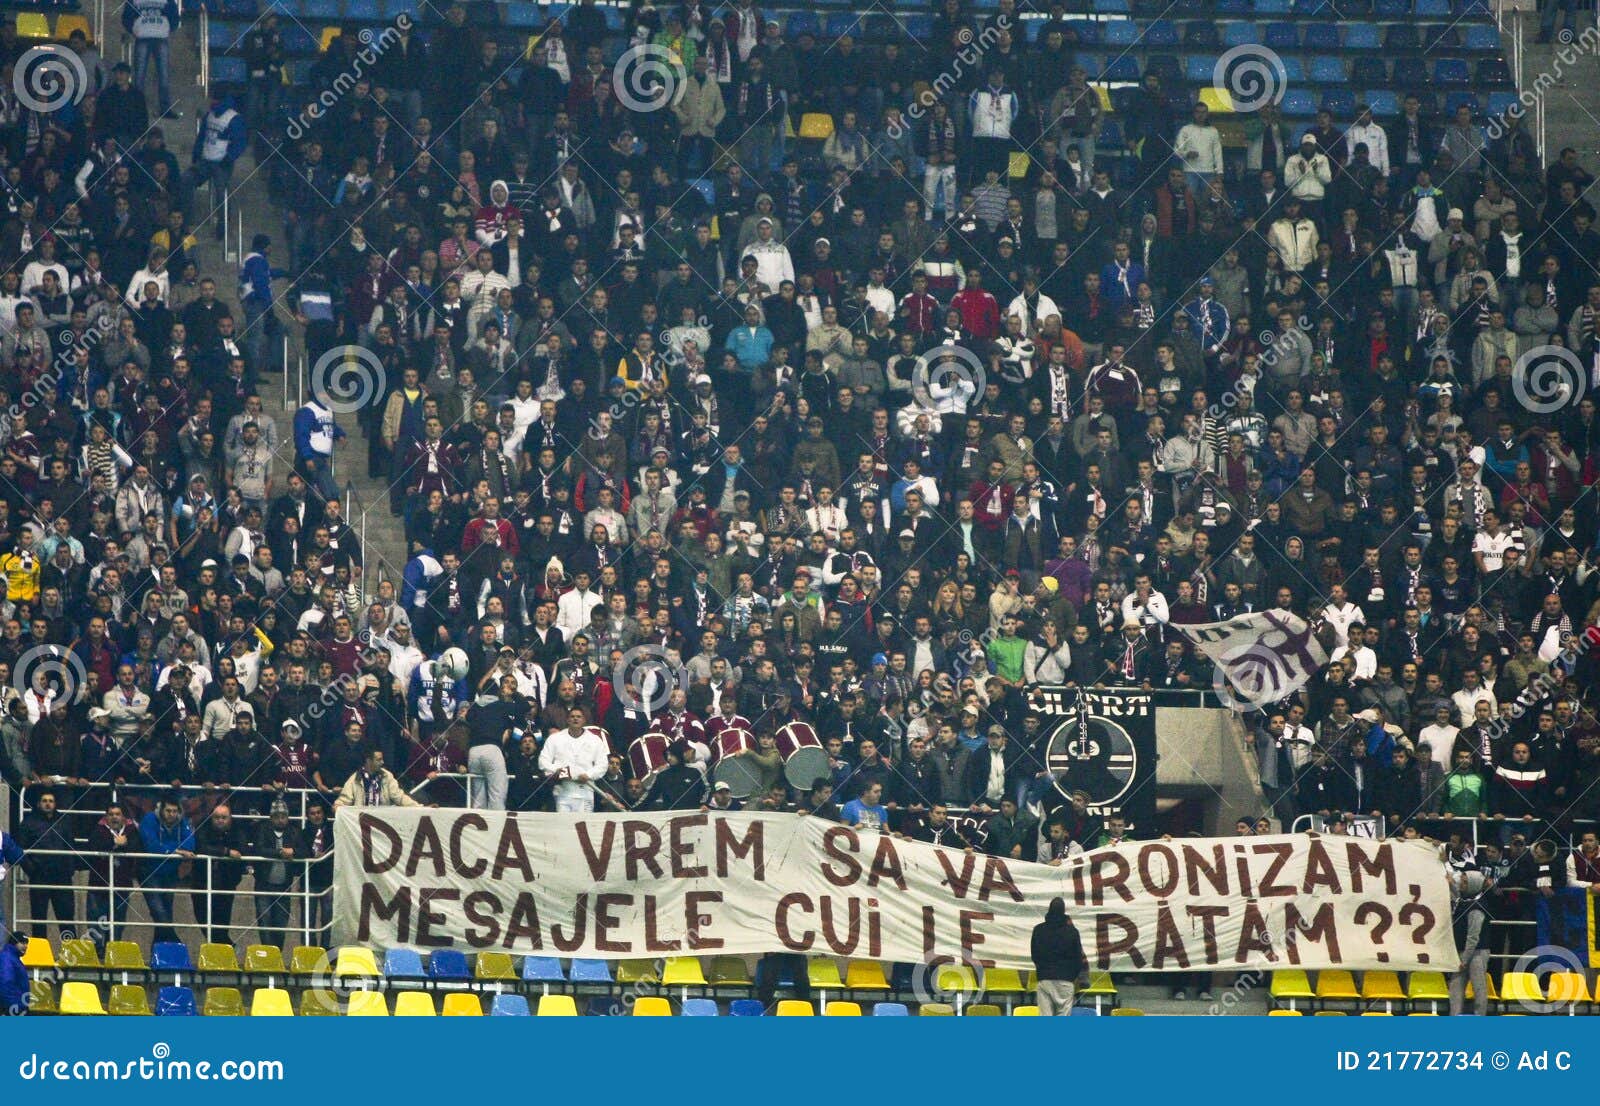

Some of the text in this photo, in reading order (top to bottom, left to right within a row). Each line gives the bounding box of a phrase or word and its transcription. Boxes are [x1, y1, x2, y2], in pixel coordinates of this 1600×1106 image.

[575, 815, 765, 882] VREM
[358, 882, 725, 952] MESAJELE
[922, 905, 996, 969] LE
